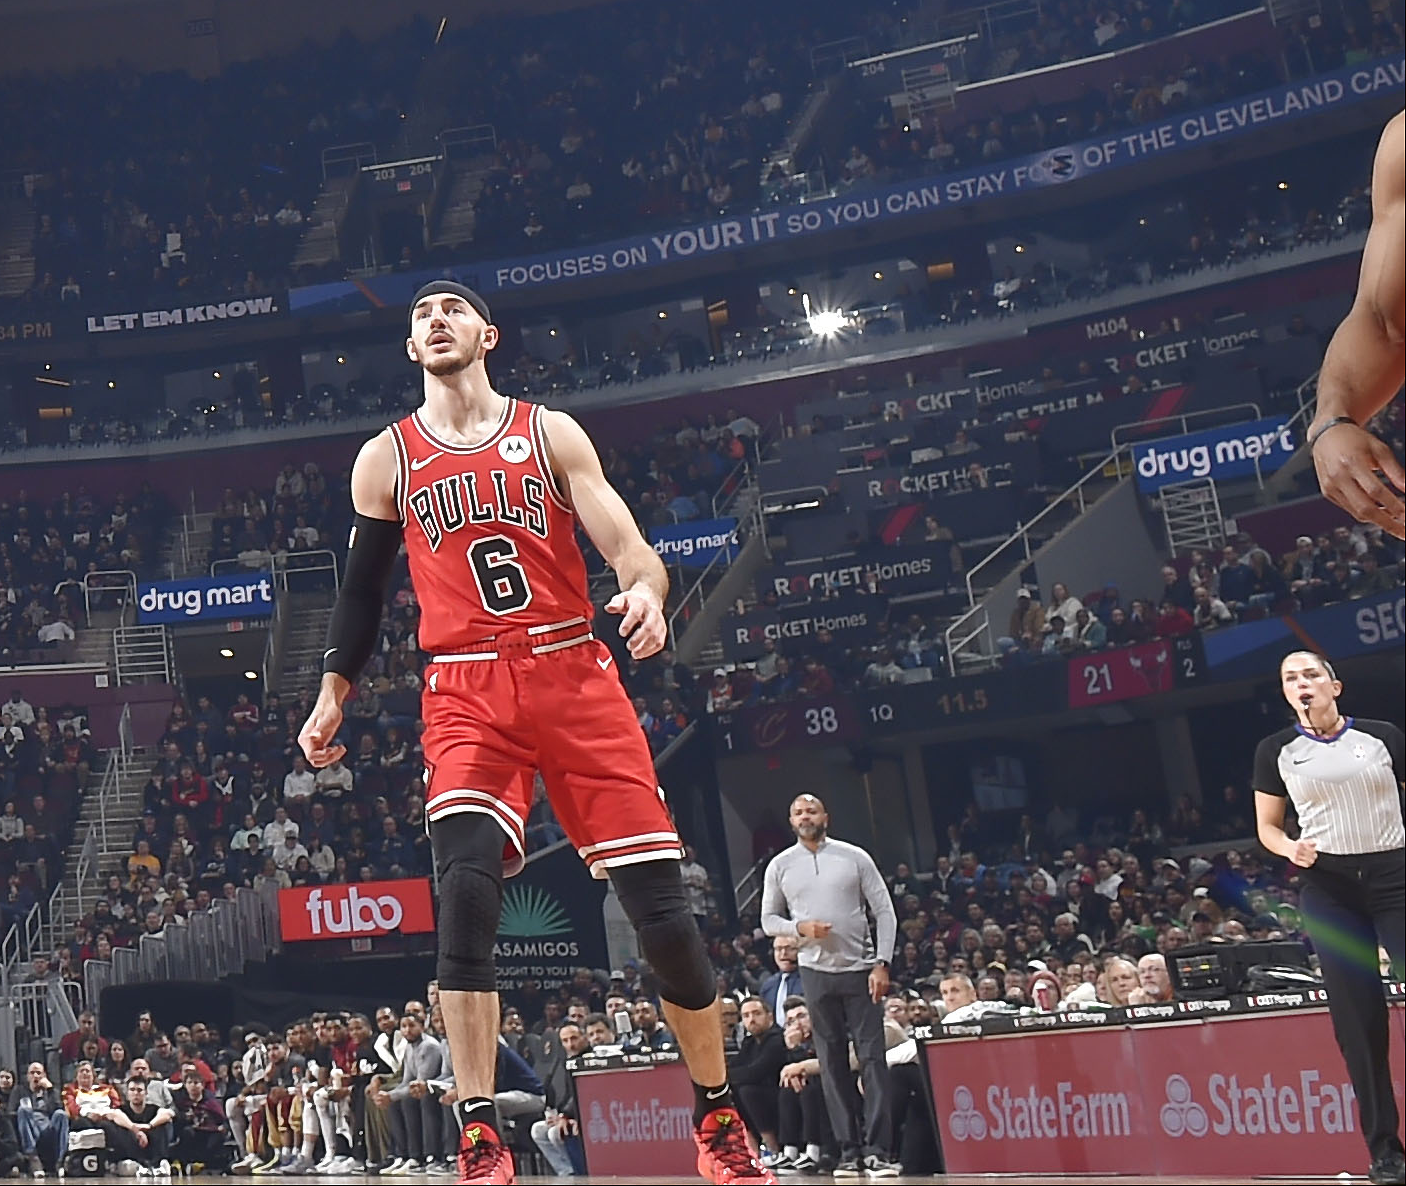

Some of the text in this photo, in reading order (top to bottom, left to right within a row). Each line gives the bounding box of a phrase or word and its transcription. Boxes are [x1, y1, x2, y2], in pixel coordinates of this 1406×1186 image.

[1082, 80, 1344, 168] OF THE CLEVELAND
[496, 254, 605, 287] FOCUSES
[612, 245, 648, 270] ON
[652, 221, 744, 261] YOUR
[751, 213, 780, 241] IT
[788, 211, 822, 234] SO
[827, 198, 880, 225] YOU
[886, 187, 941, 214] CAN
[946, 171, 1008, 202] STAY
[88, 297, 278, 332] LET EM KNOW.
[1087, 317, 1128, 339] M104
[23, 322, 52, 339] PM
[1137, 425, 1295, 478] drug mart
[868, 473, 951, 497] ROCKET
[408, 470, 548, 553] BULLS
[653, 531, 739, 555] drug mart
[466, 534, 532, 616] 6
[775, 557, 932, 595] ROCKET Homes
[140, 579, 272, 615] drug mart
[736, 612, 867, 644] ROCKET Homes
[1084, 664, 1113, 695] 21
[1183, 659, 1195, 678] 2
[870, 704, 893, 722] 1Q
[939, 690, 987, 714] 11.5
[805, 707, 838, 735] 38
[306, 886, 402, 934] fubo
[492, 942, 579, 956] ASAMIGOS
[1208, 1069, 1355, 1135] StateFar
[83, 1154, 98, 1171] G
